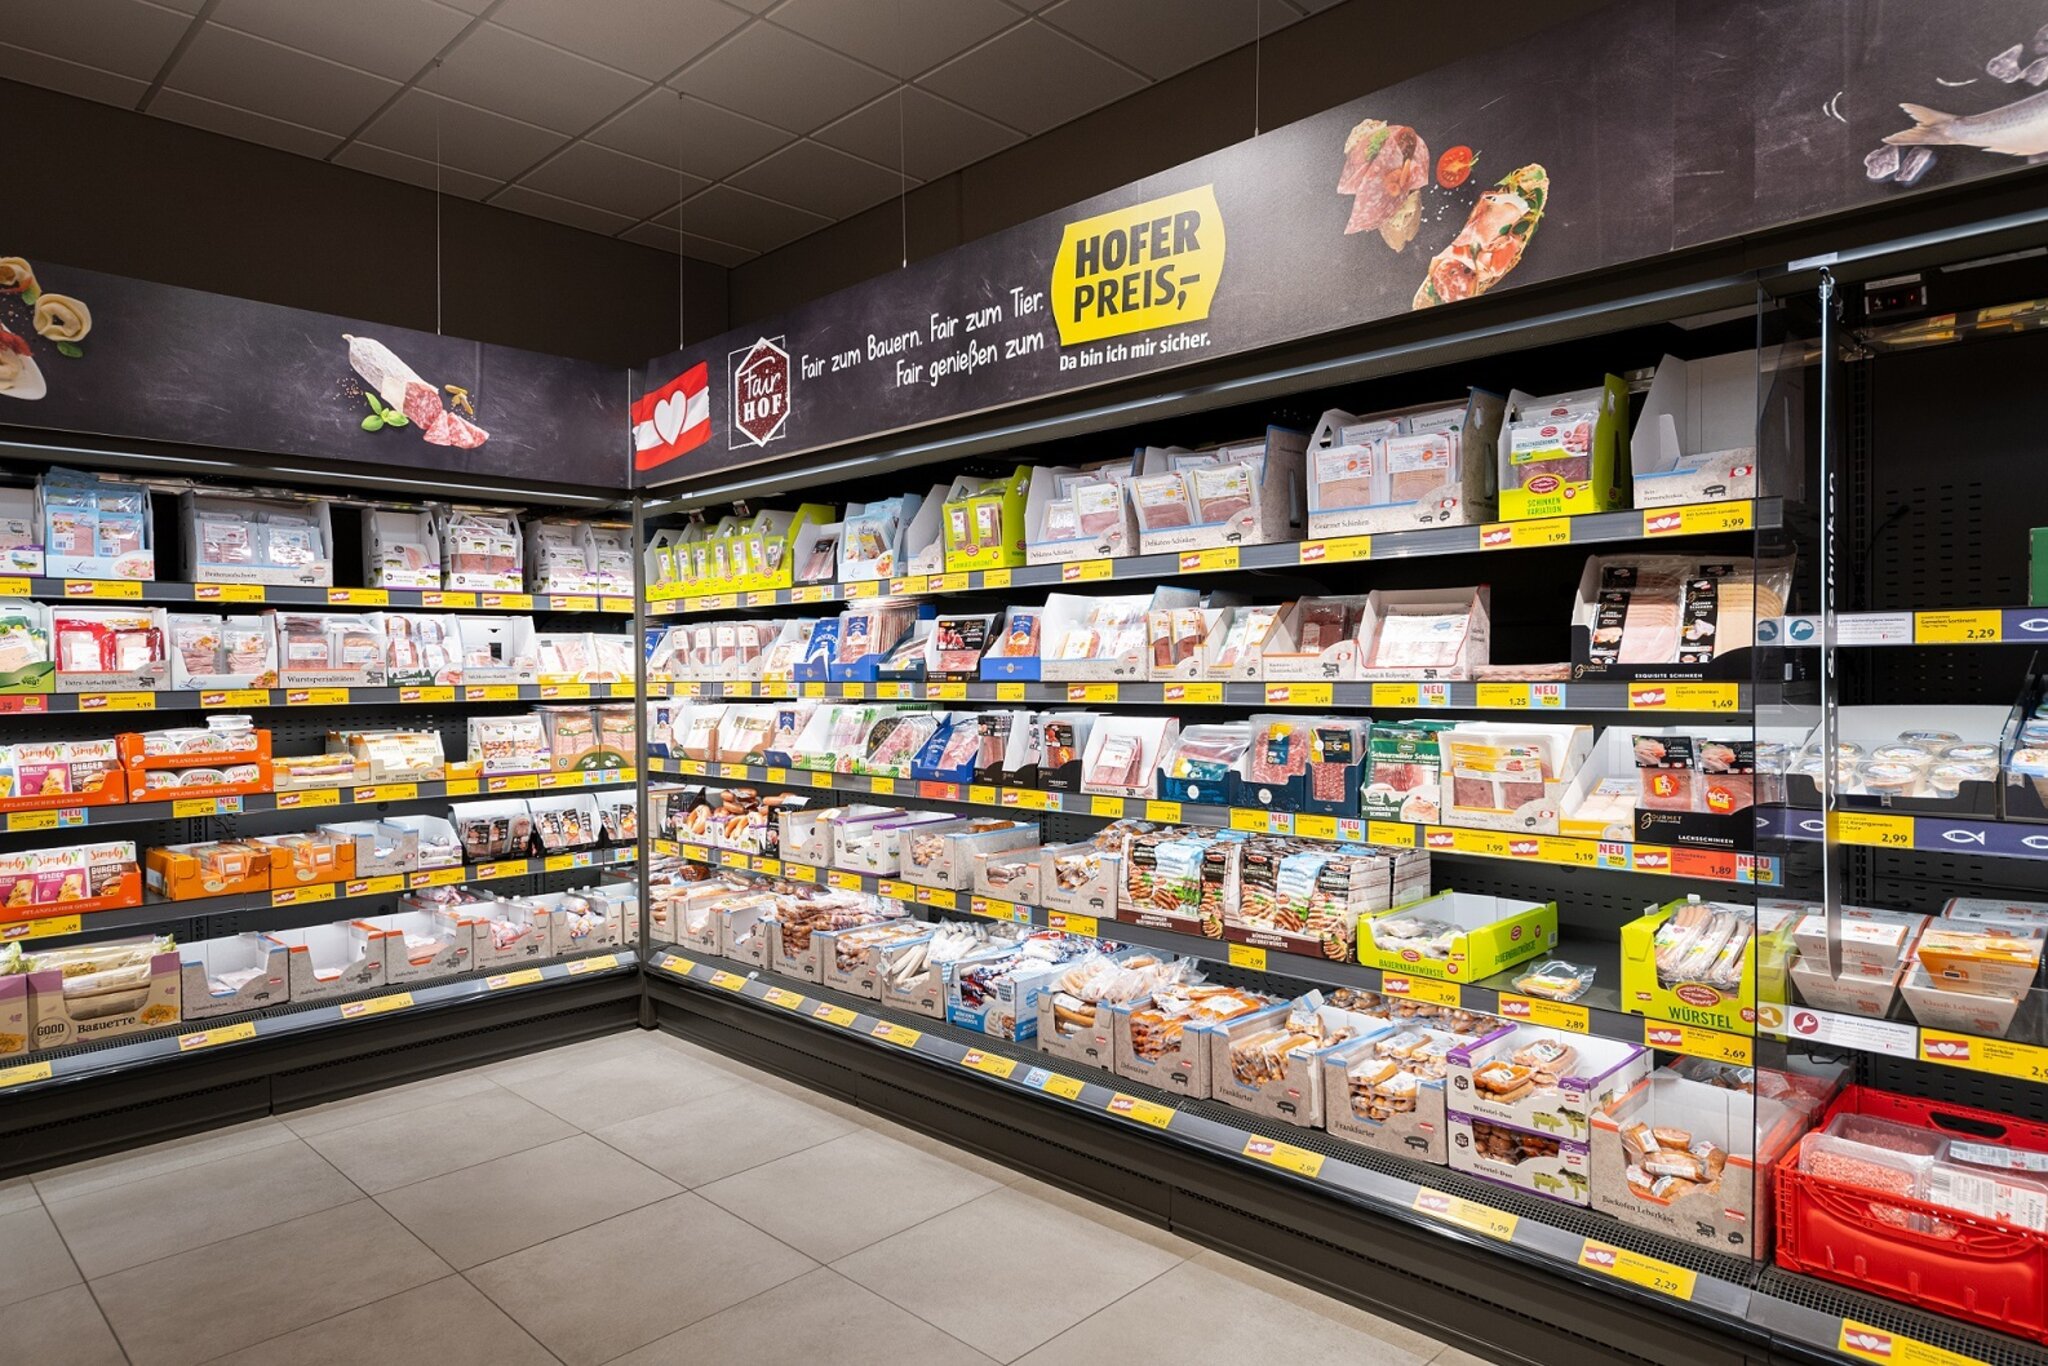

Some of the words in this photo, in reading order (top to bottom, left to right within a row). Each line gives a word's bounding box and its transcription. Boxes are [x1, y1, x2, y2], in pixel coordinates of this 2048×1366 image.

[1075, 208, 1200, 278] HOFER
[801, 355, 823, 380] Fair
[831, 349, 861, 373] zum
[867, 327, 923, 362] Bauern.
[930, 312, 956, 340] Fair
[965, 307, 1002, 333] zum
[1010, 286, 1044, 318] Tier.
[1060, 355, 1080, 371] Da
[1082, 349, 1102, 367] bin
[1106, 345, 1128, 364] ich
[1131, 342, 1155, 360] mir
[1159, 332, 1211, 356] sicher.
[896, 361, 923, 388] Fair
[929, 345, 998, 387] genießen
[1005, 333, 1044, 357] zum
[738, 355, 782, 398] Fair
[743, 396, 783, 424] HOF
[1527, 497, 1561, 507] SCHINKEN
[1527, 505, 1562, 516] VARIATION
[1341, 517, 1370, 528] Schinken
[1722, 518, 1744, 528] 3,99
[1548, 533, 1566, 542] 1,99
[1352, 550, 1367, 558] 1,89
[1967, 629, 1995, 639] 2,29
[1423, 685, 1444, 695] NEU
[1534, 685, 1558, 695] NEU
[1509, 697, 1526, 706] 1,25
[1712, 700, 1733, 709] 1,49
[1371, 751, 1414, 759] Schwarzwälder
[71, 761, 103, 771] BURGER
[61, 809, 81, 817] NEU
[1271, 814, 1288, 823] NEU
[1341, 820, 1359, 829] NEU
[1678, 834, 1734, 844] LACHSSCHINKEN
[1882, 833, 1907, 843] 2,99
[1486, 843, 1503, 852] 1,99
[1599, 843, 1624, 855] NEU
[1575, 852, 1593, 861] 1,19
[1738, 856, 1771, 869] NEU
[91, 864, 122, 874] BURGER
[1710, 865, 1731, 875] 1,89
[1669, 1006, 1733, 1029] WÜRSTEL
[37, 1023, 65, 1036] GOOD
[77, 1016, 136, 1034] Baguette
[1566, 1020, 1584, 1029] 2,89
[1723, 1048, 1746, 1058] 2,69
[2031, 1066, 2048, 1078] 2,9
[1219, 1085, 1253, 1102] Frankfurter
[1335, 1121, 1375, 1138] Frankfurter
[1602, 1195, 1636, 1212] Backofen
[1637, 1205, 1674, 1224] Leberkäse
[1490, 1222, 1509, 1234] 1,99
[1654, 1278, 1678, 1292] 2,29
